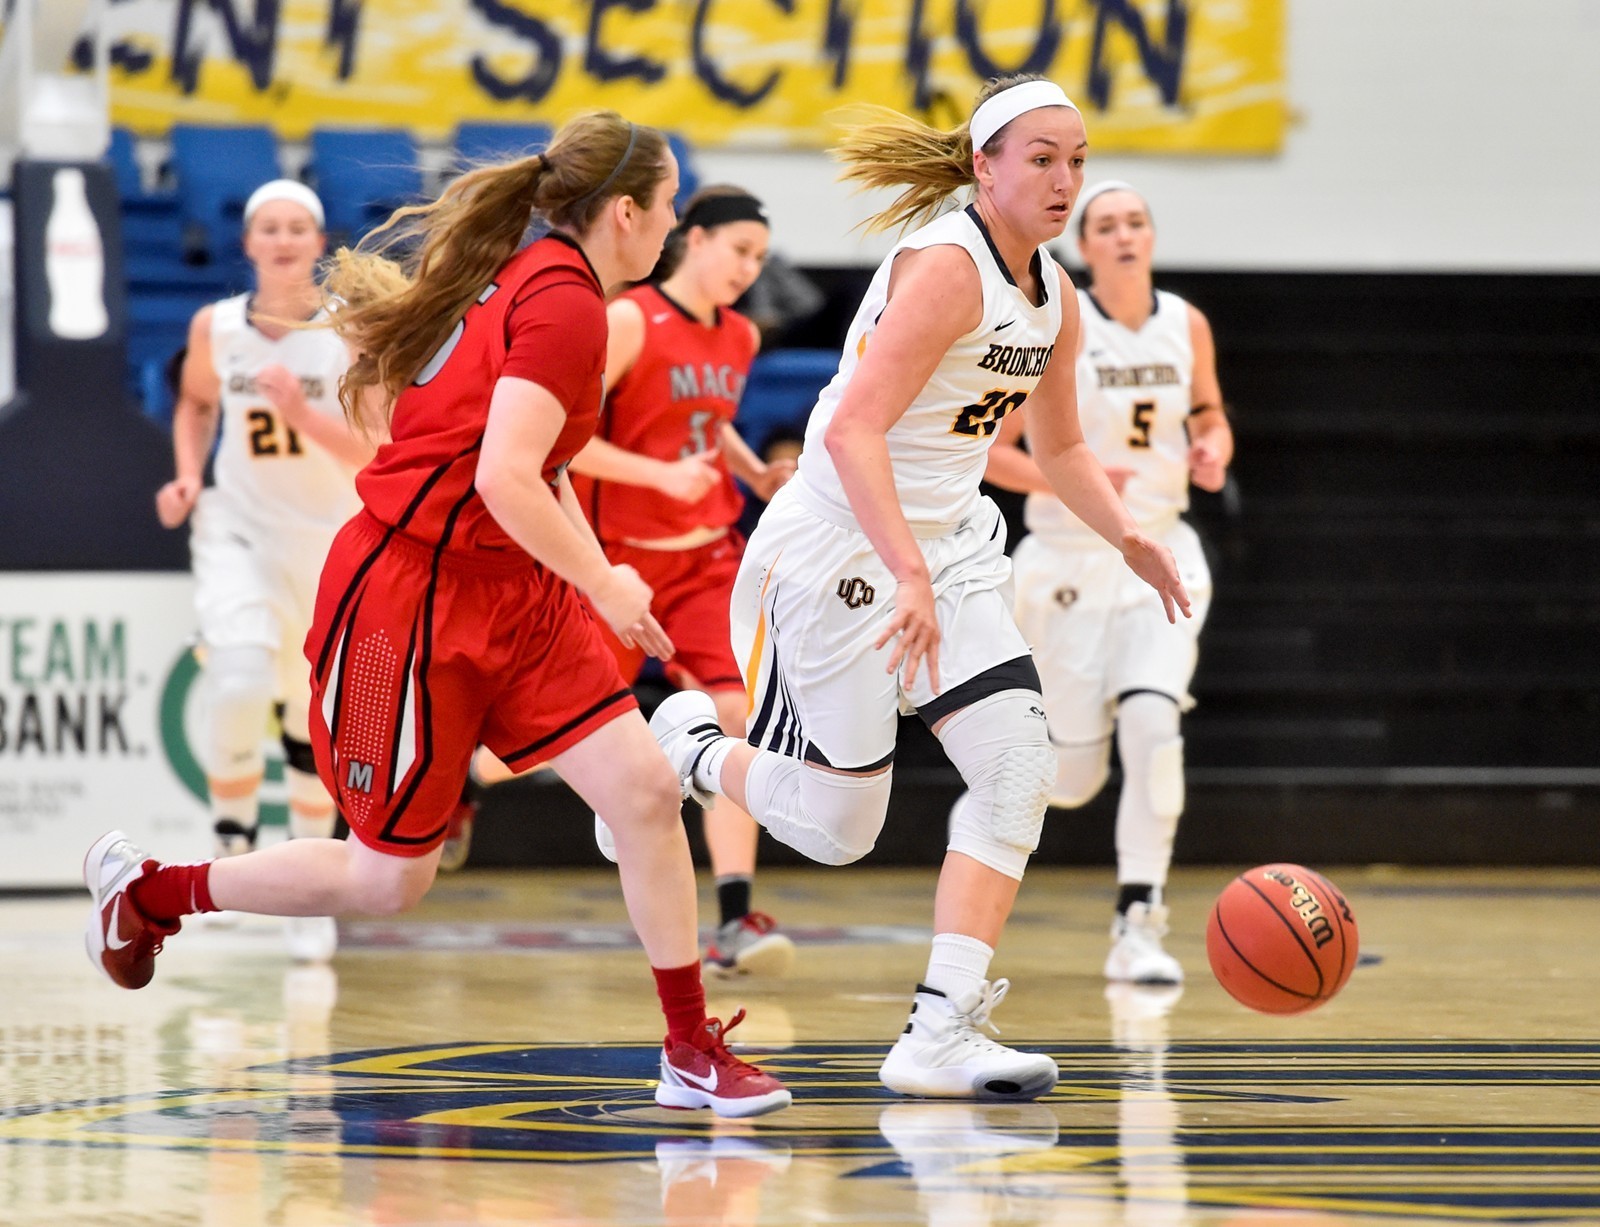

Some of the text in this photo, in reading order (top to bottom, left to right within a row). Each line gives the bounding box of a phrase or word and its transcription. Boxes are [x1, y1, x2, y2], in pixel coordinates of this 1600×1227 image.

[246, 408, 305, 458] 21
[949, 387, 1030, 439] 20
[1127, 400, 1156, 450] 5
[0, 617, 148, 686] EAM.
[346, 760, 374, 794] M
[1263, 869, 1334, 949] Wilson
